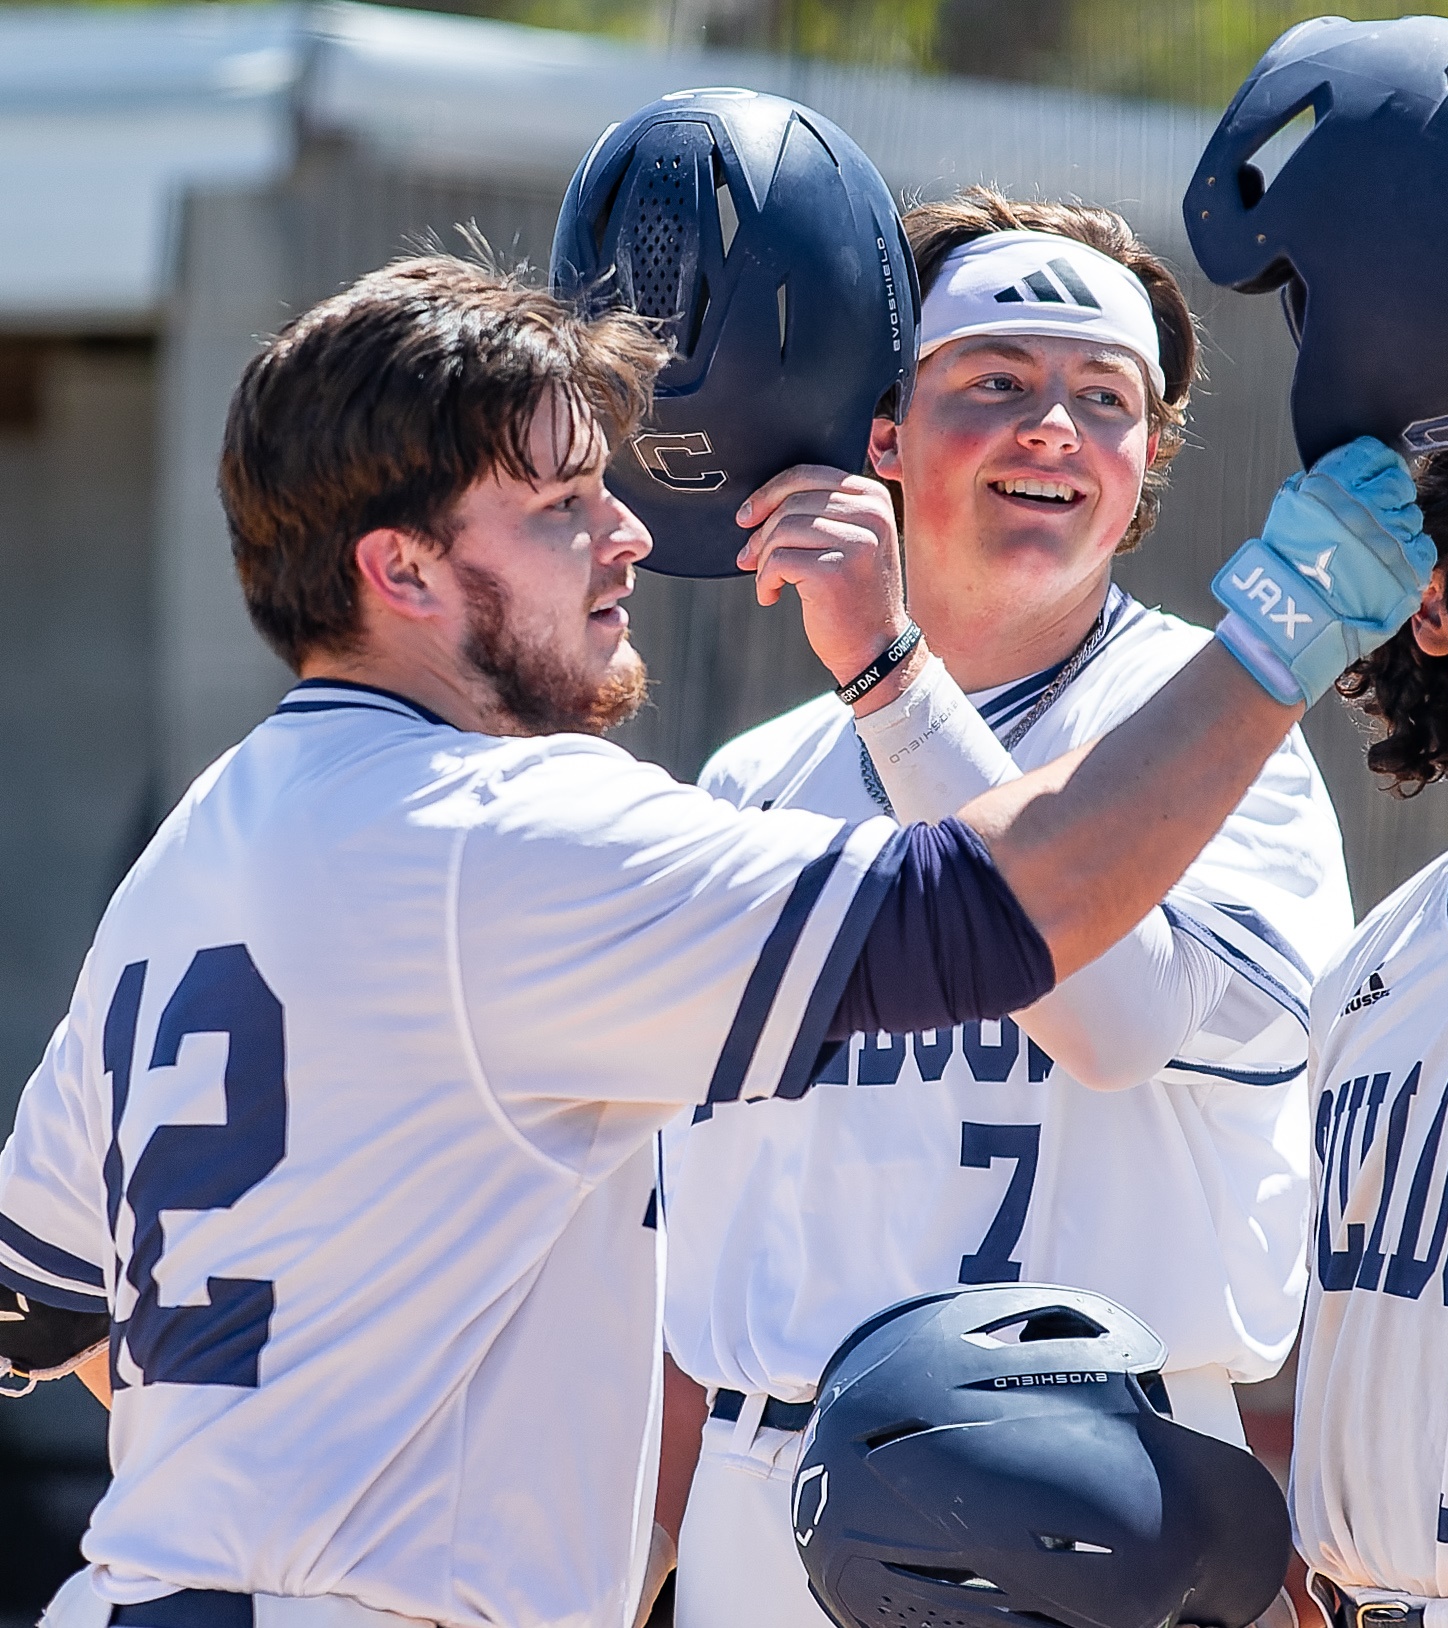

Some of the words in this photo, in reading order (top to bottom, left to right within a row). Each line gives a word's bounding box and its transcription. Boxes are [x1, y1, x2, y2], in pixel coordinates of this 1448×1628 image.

[877, 237, 901, 352] EVOSHIELD
[631, 431, 728, 493] C
[1232, 566, 1313, 640] JAX
[840, 684, 860, 703] ERY
[857, 666, 880, 690] DAY
[103, 943, 288, 1390] 12
[958, 1121, 1042, 1285] 7
[994, 1372, 1109, 1388] EVOSHIELD
